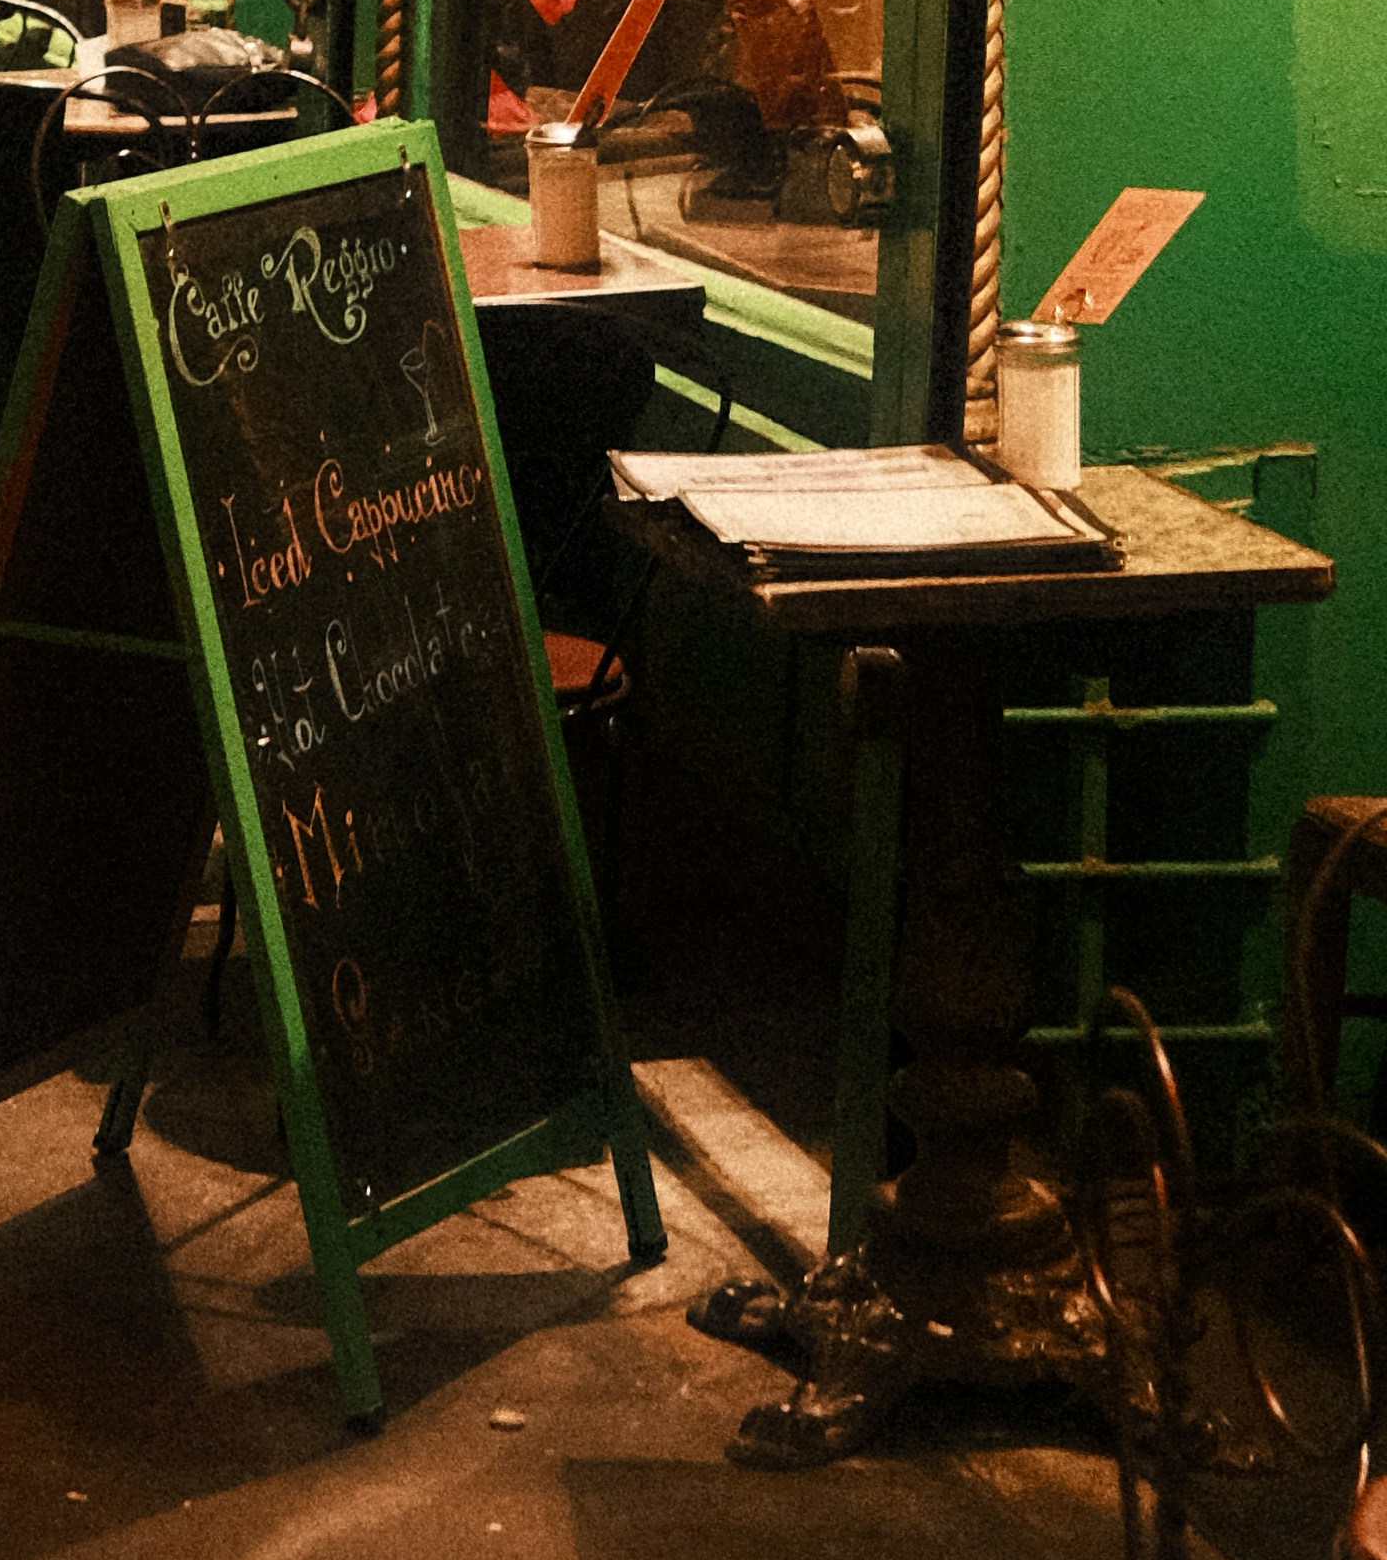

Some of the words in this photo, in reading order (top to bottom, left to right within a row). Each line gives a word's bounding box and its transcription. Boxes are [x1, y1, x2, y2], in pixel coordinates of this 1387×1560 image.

[169, 264, 264, 387] Caffe
[261, 226, 396, 345] Reggio
[221, 492, 313, 608] Iced
